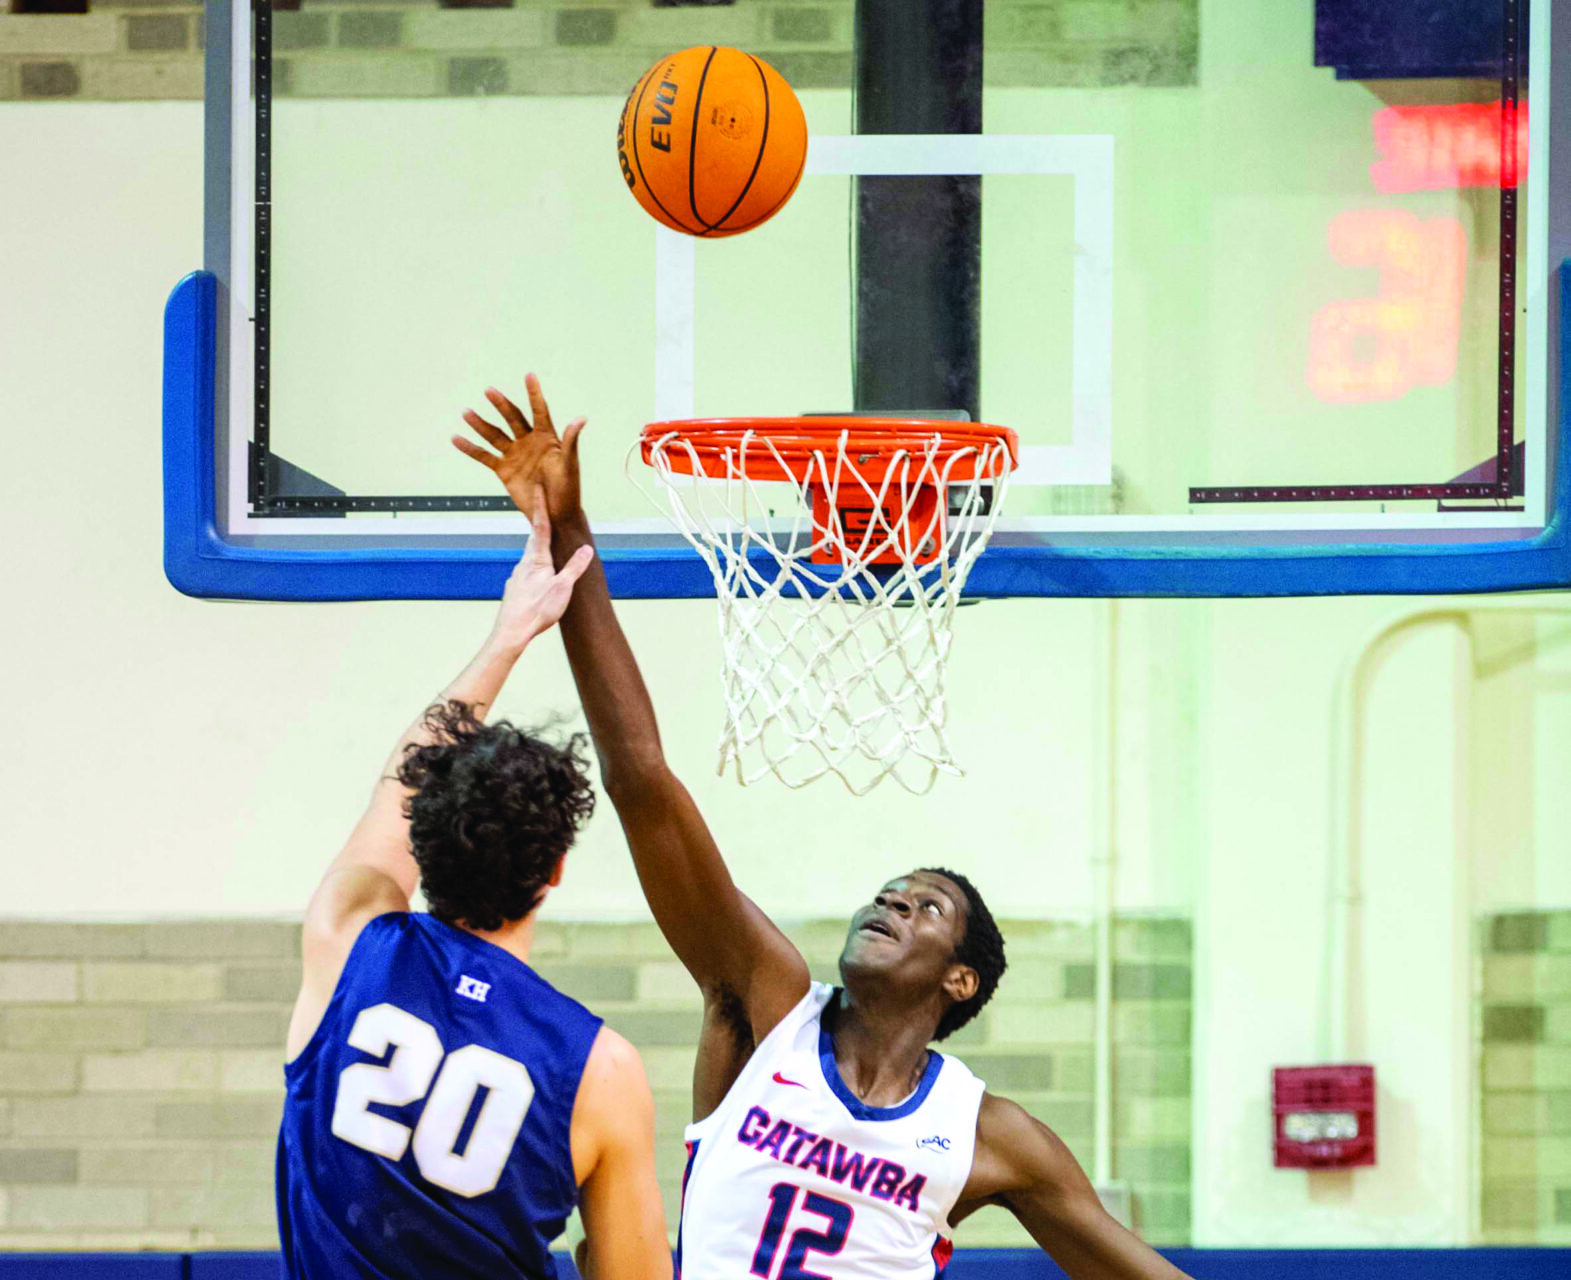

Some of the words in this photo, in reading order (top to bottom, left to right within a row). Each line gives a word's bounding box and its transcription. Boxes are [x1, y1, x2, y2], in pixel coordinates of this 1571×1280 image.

[651, 80, 678, 153] EVO
[455, 974, 491, 1002] KH
[331, 1002, 535, 1198] 20
[737, 1105, 927, 1212] CATAWBA
